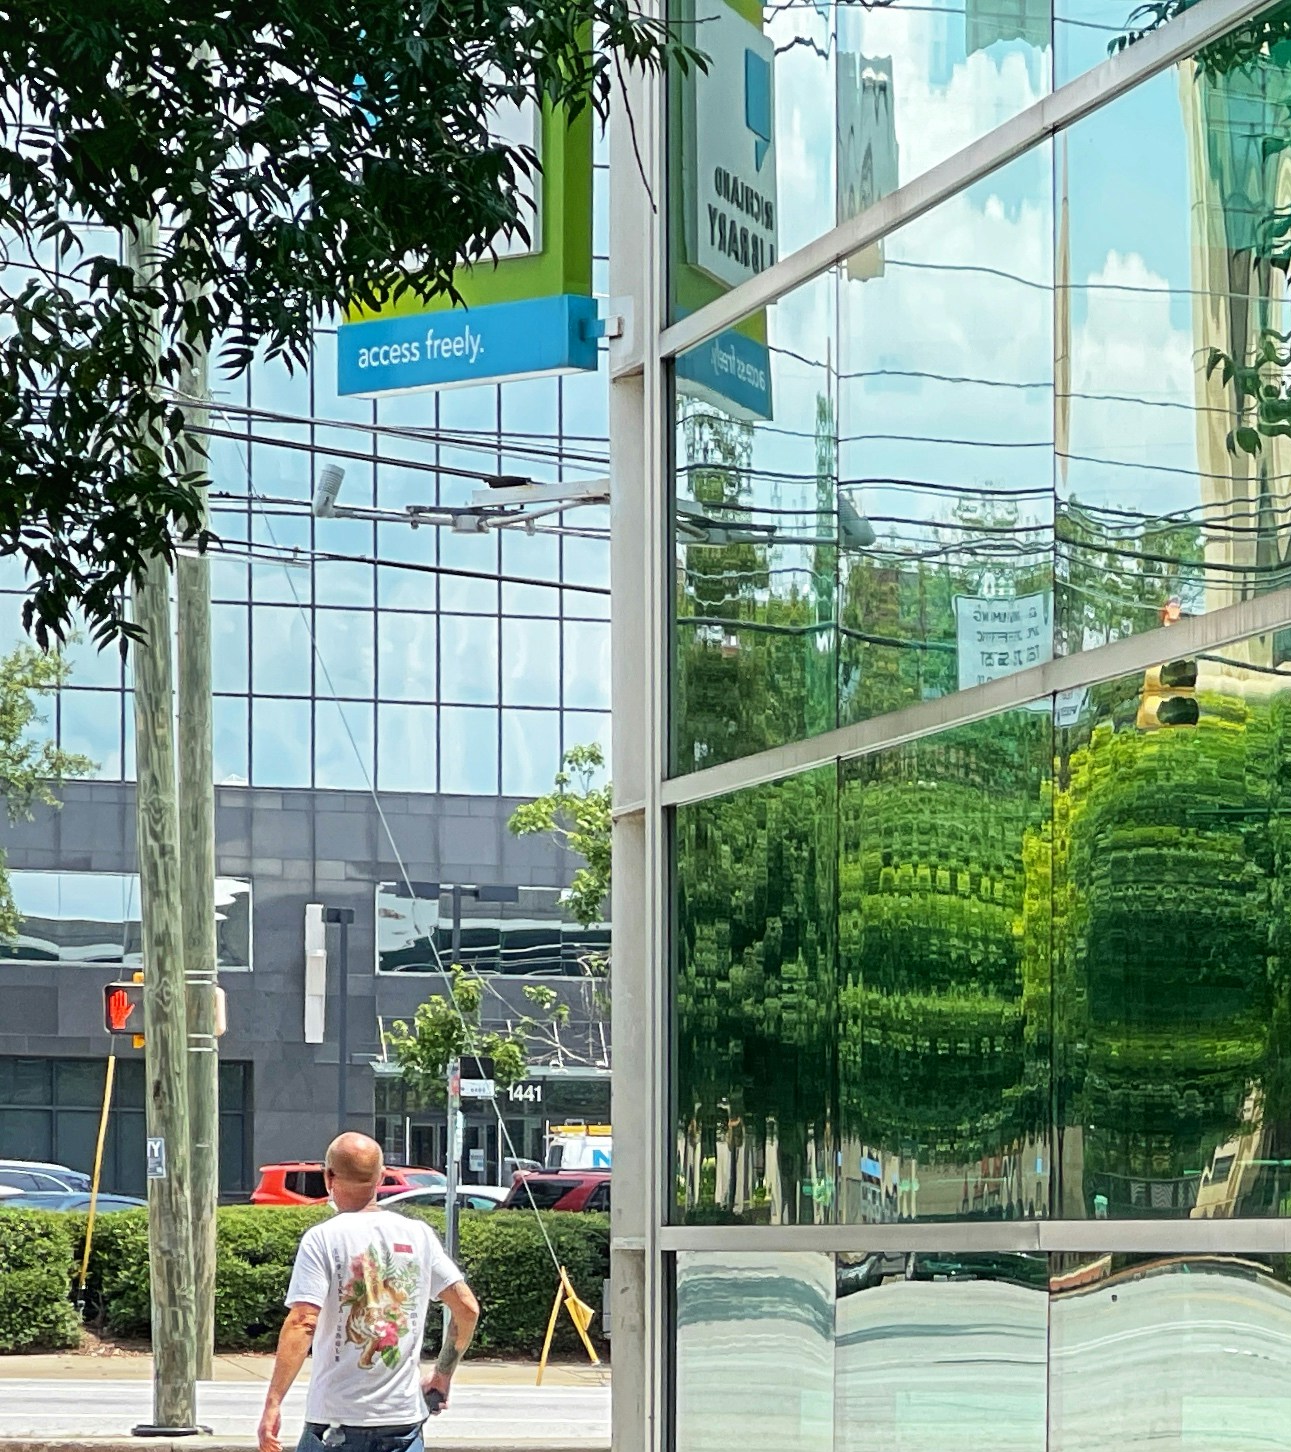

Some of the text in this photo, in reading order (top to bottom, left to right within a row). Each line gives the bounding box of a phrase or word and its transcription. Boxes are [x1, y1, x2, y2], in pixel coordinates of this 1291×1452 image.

[358, 325, 485, 369] access freely.
[507, 1084, 542, 1102] 1441
